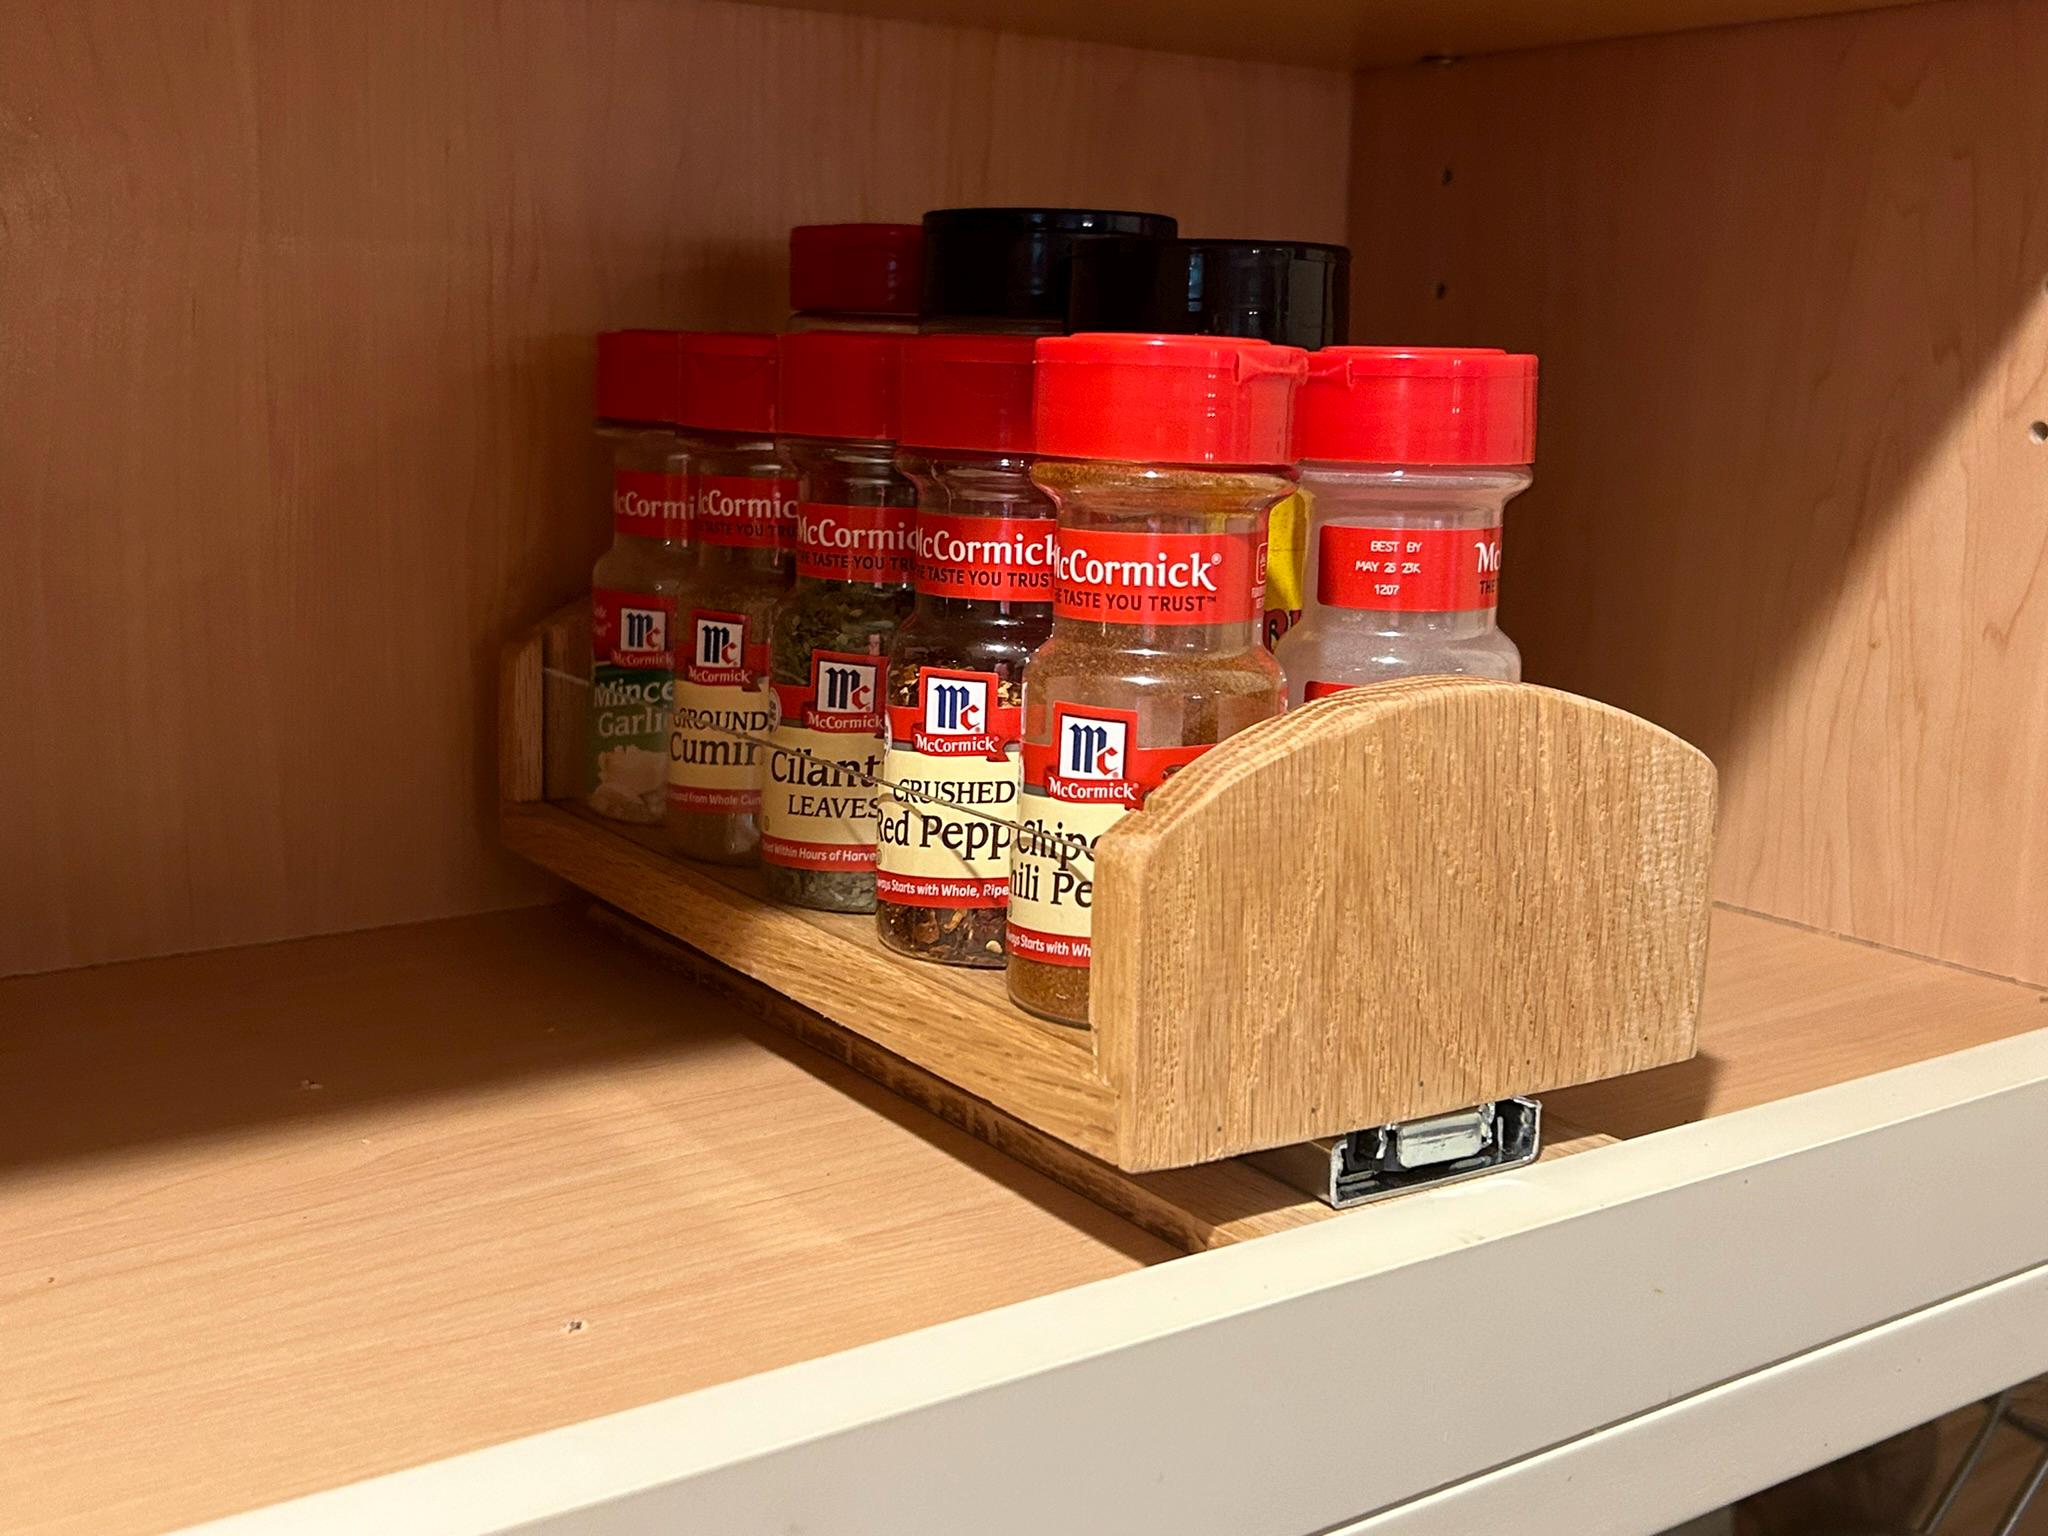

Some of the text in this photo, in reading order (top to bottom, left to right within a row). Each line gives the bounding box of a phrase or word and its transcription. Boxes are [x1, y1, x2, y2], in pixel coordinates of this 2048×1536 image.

[614, 490, 695, 520] cCormi
[1370, 540, 1423, 553] BEST BY
[812, 551, 849, 568] TASTE
[853, 556, 884, 570] YOU
[1355, 560, 1379, 573] MAY
[928, 566, 965, 585] TASTE
[968, 570, 1002, 586] YOU
[1063, 588, 1101, 609] TASTE
[1105, 592, 1142, 611] YOU
[1374, 584, 1400, 596] 1207
[688, 665, 752, 684] McCormick
[599, 705, 668, 737] Garli
[673, 706, 769, 731] GROUND
[806, 710, 884, 730] McCormick
[913, 733, 997, 754] McCormick
[771, 747, 881, 788] Cilant
[893, 777, 1016, 805] CRUSHED
[1048, 777, 1136, 801] McCormick
[788, 793, 879, 819] LEAVES
[920, 814, 1012, 862] Pepp
[799, 846, 827, 861] Hours
[828, 849, 842, 861] of
[842, 849, 876, 863] Harve
[891, 879, 916, 896] Starts
[916, 884, 939, 896] with
[940, 883, 981, 898] Whole,
[982, 883, 1009, 900] Ripe
[1050, 871, 1093, 908] Pe
[1020, 933, 1045, 953] Starts
[1045, 939, 1070, 957] with
